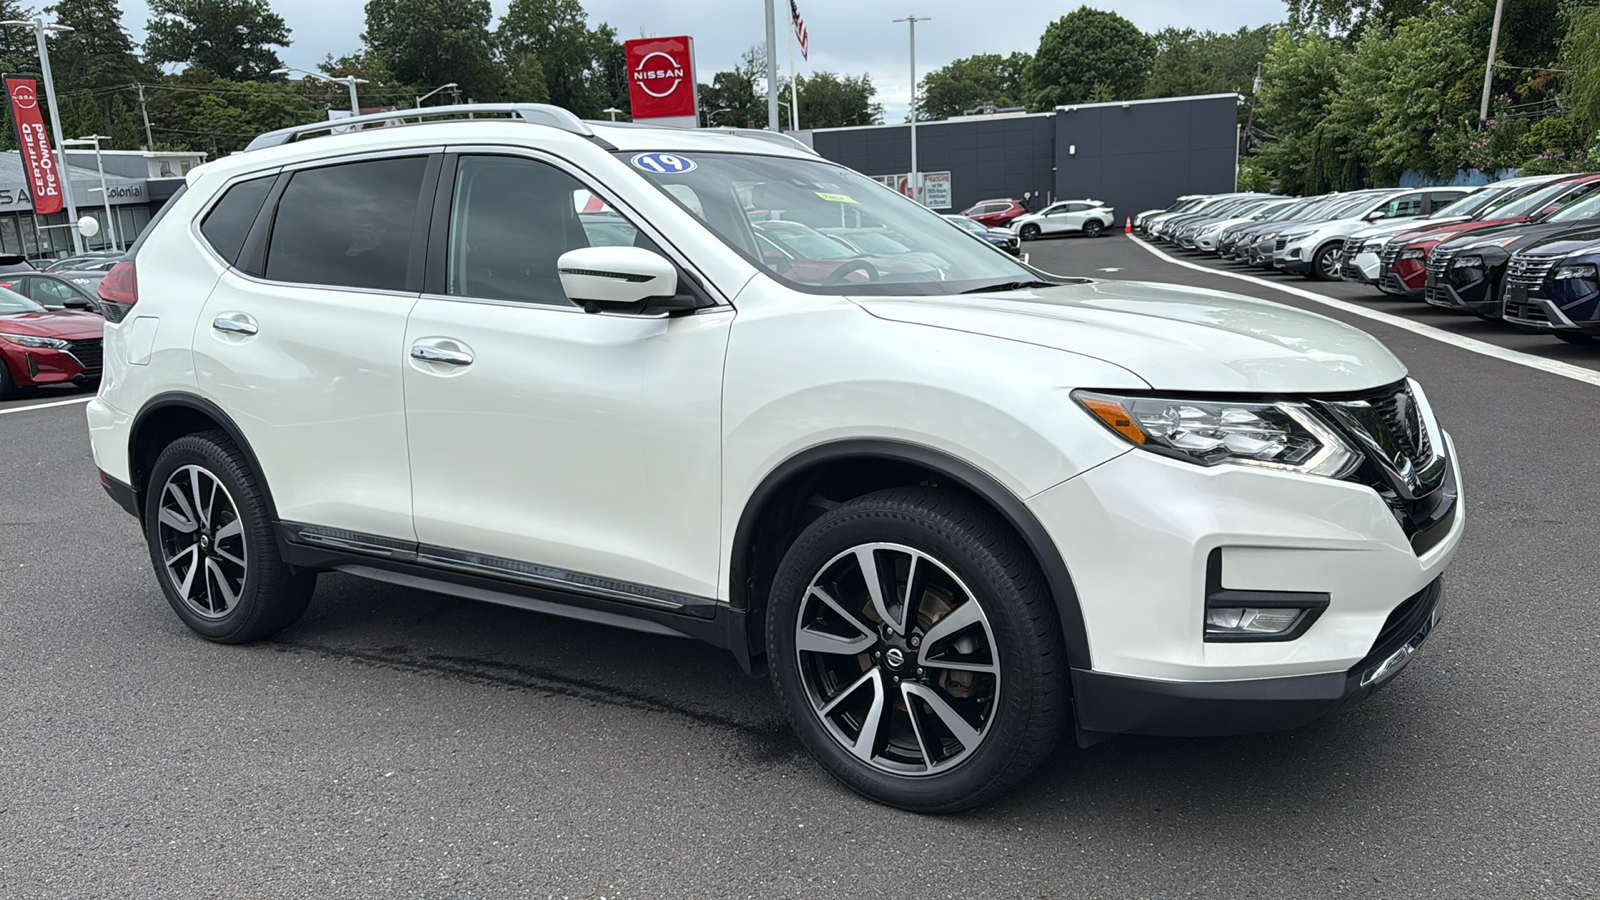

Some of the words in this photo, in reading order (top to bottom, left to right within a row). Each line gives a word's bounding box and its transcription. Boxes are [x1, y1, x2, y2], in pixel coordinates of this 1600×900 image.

[634, 69, 684, 80] NISSAN
[21, 123, 46, 197] CERTIFIED
[31, 123, 59, 196] Pre-Owned
[642, 154, 683, 172] 19
